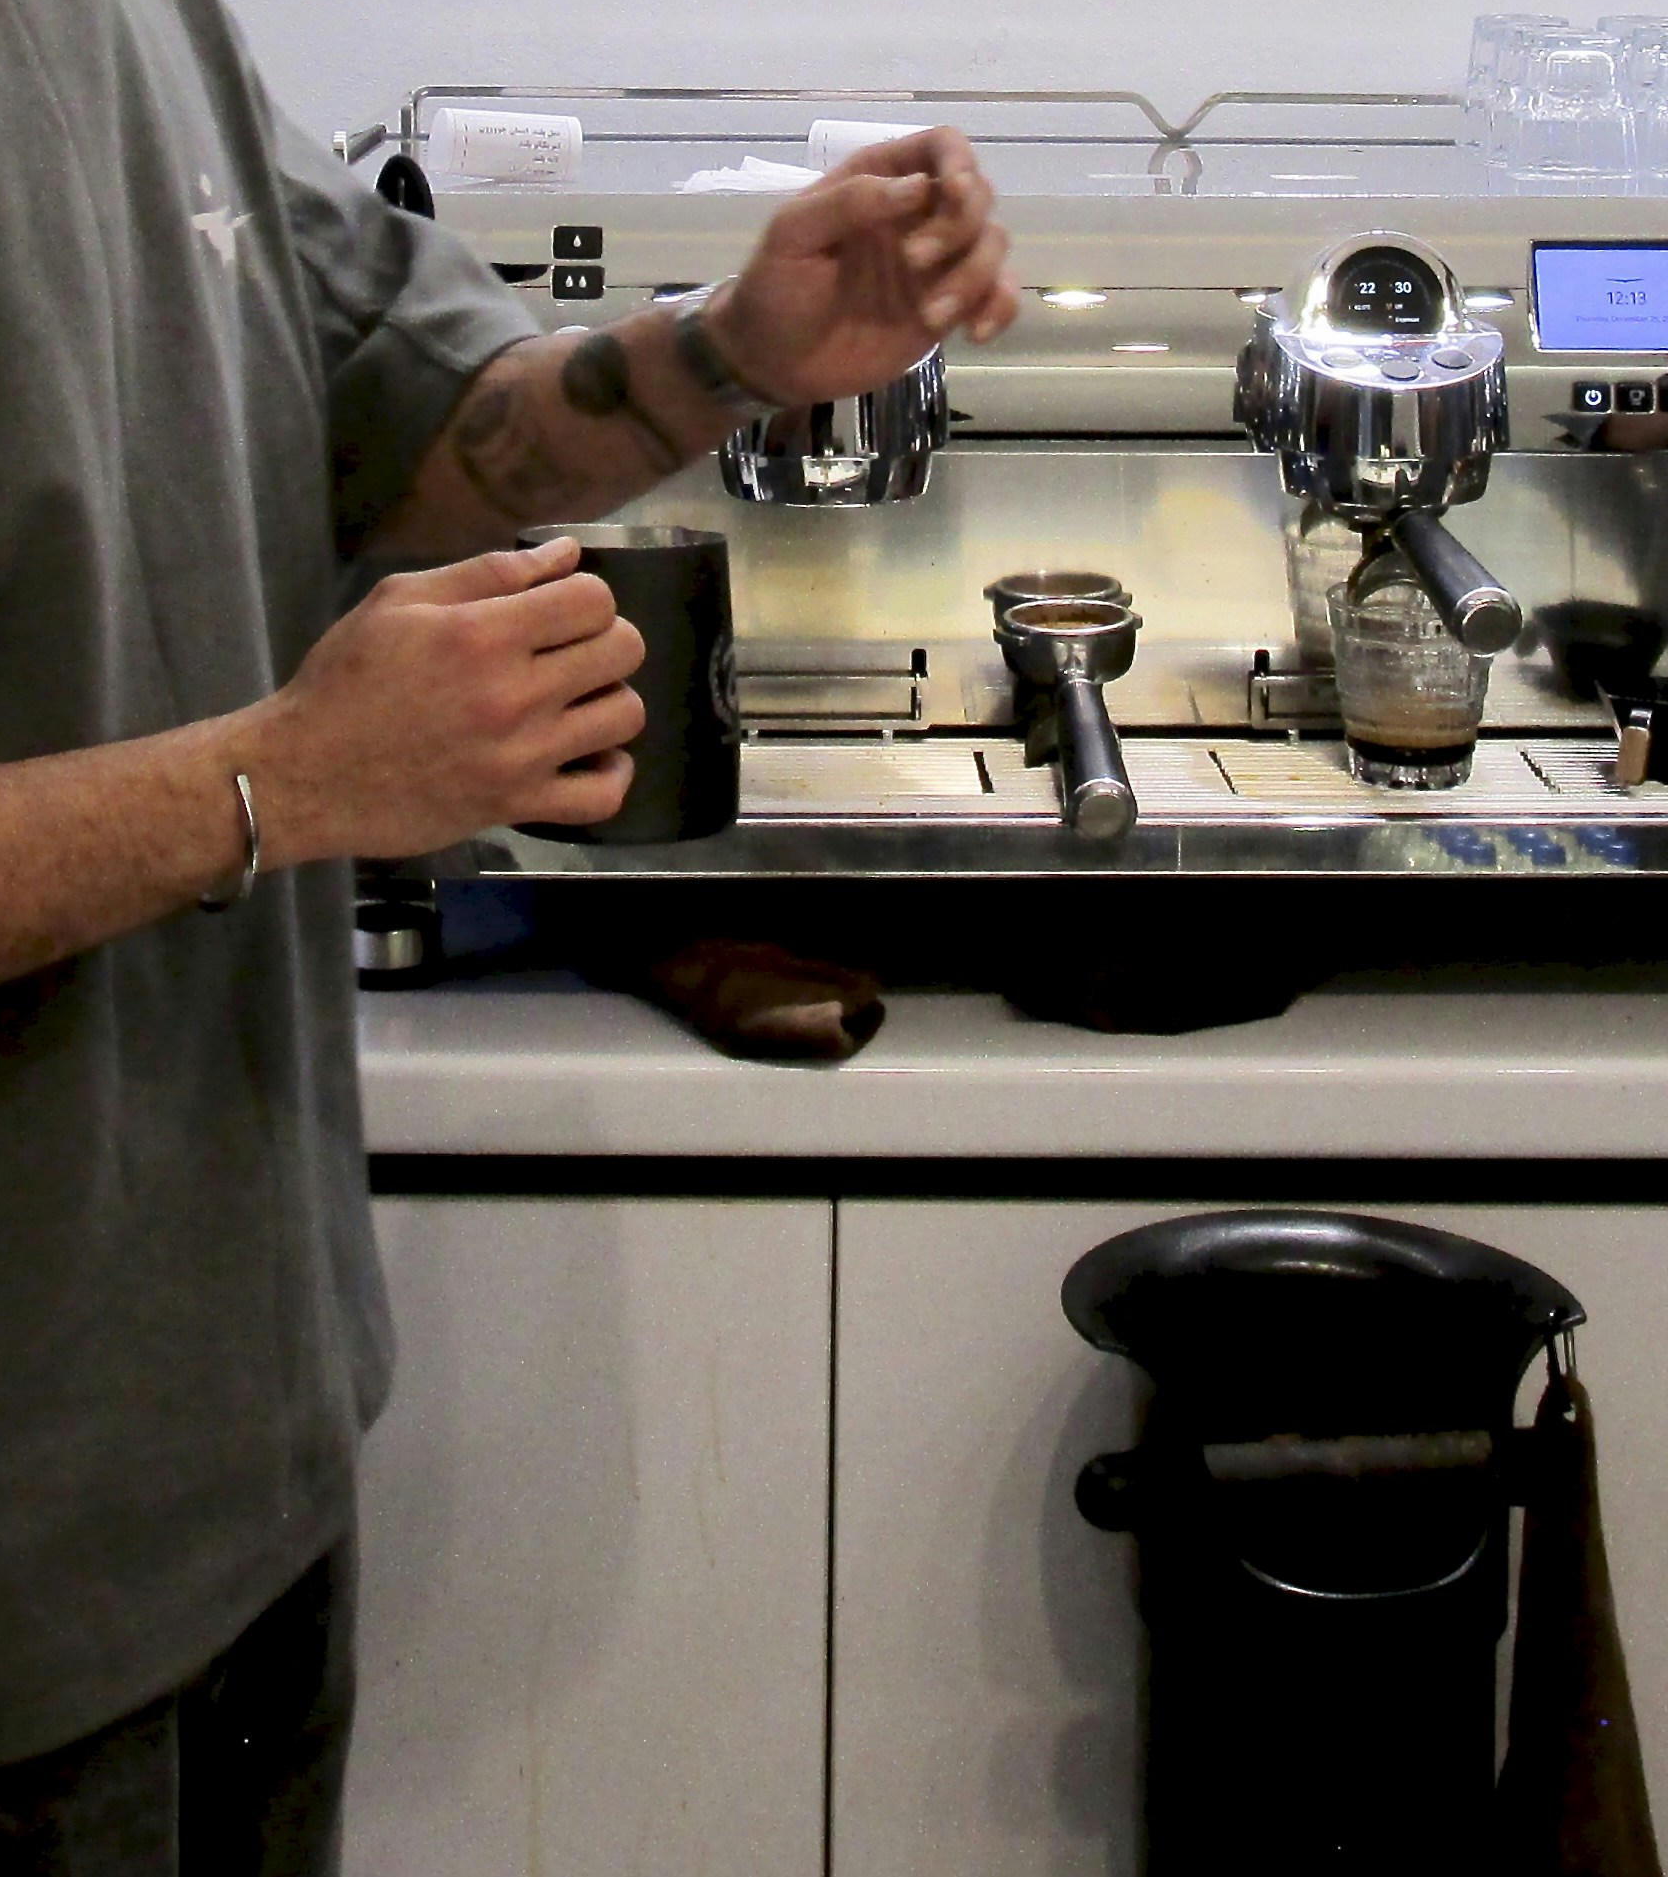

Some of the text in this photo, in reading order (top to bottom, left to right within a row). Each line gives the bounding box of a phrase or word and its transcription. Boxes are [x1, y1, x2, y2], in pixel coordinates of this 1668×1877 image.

[1359, 281, 1413, 294] 22 30
[1607, 291, 1647, 305] 12:13
